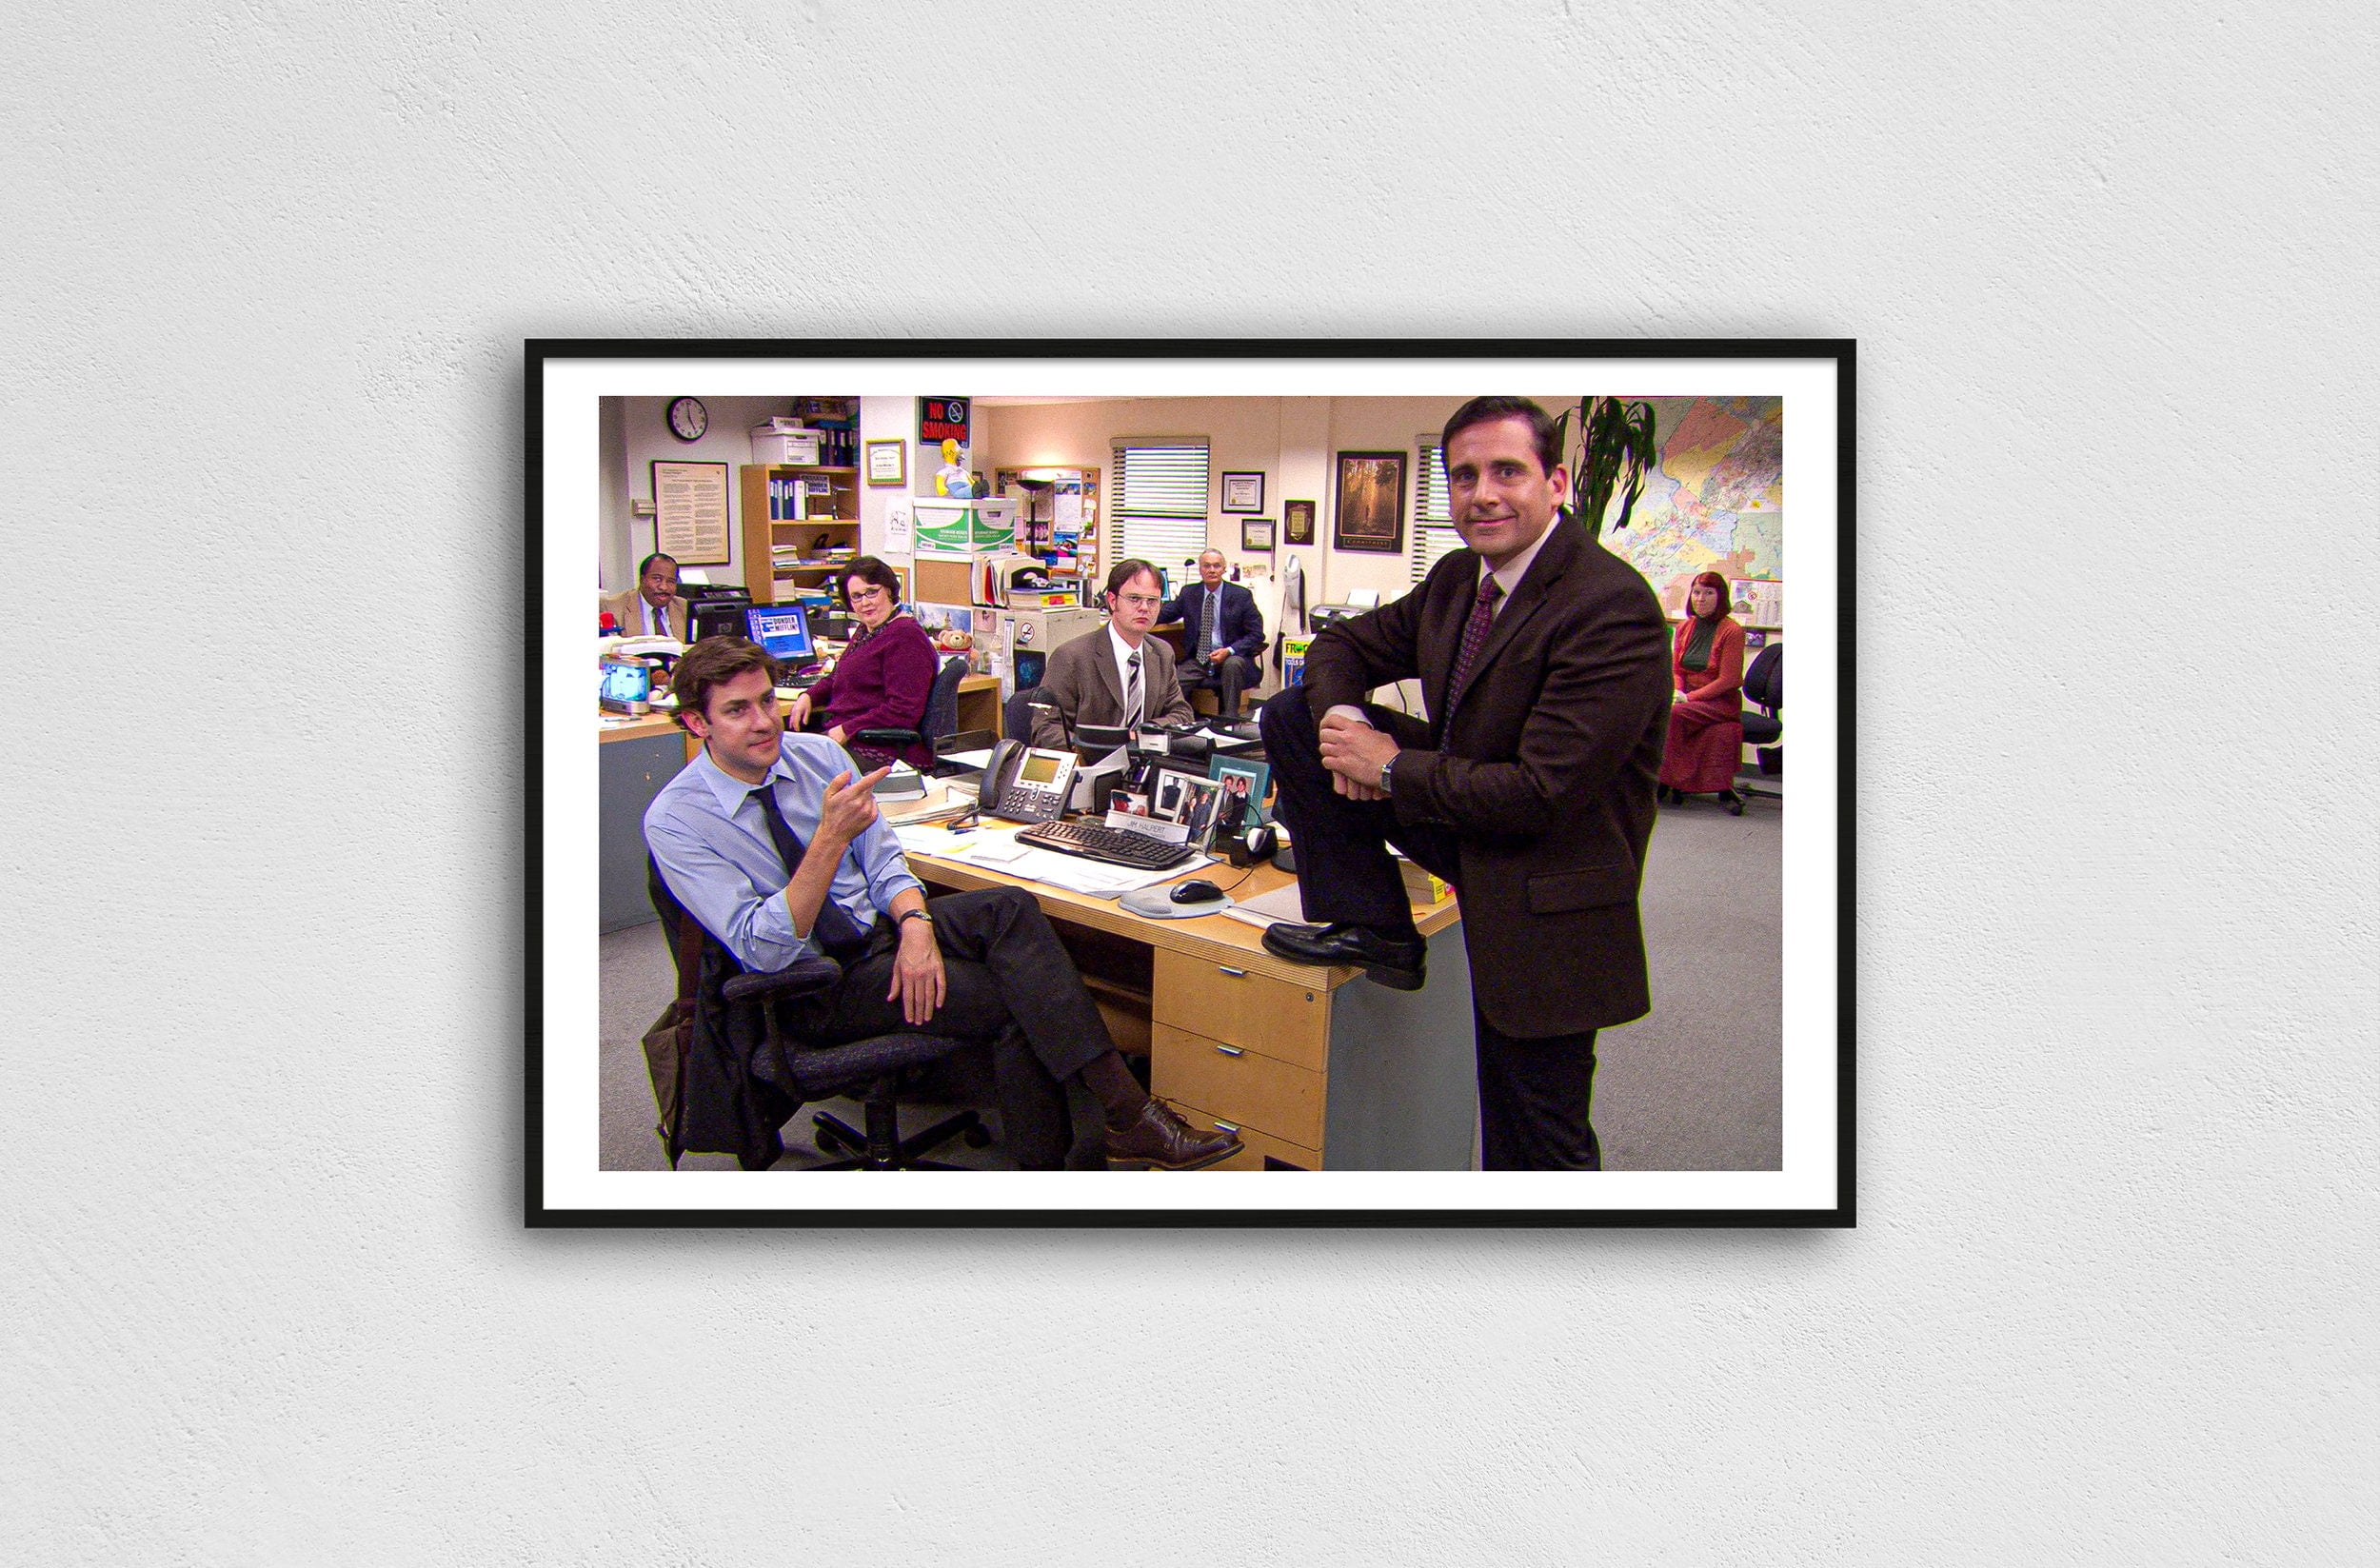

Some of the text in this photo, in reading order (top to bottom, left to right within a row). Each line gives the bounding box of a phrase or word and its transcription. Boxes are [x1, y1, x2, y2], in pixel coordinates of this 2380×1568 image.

[928, 402, 944, 420] NO
[922, 421, 967, 441] SMOKING
[773, 616, 796, 625] DUNDER
[1139, 823, 1165, 834] HALPERT
